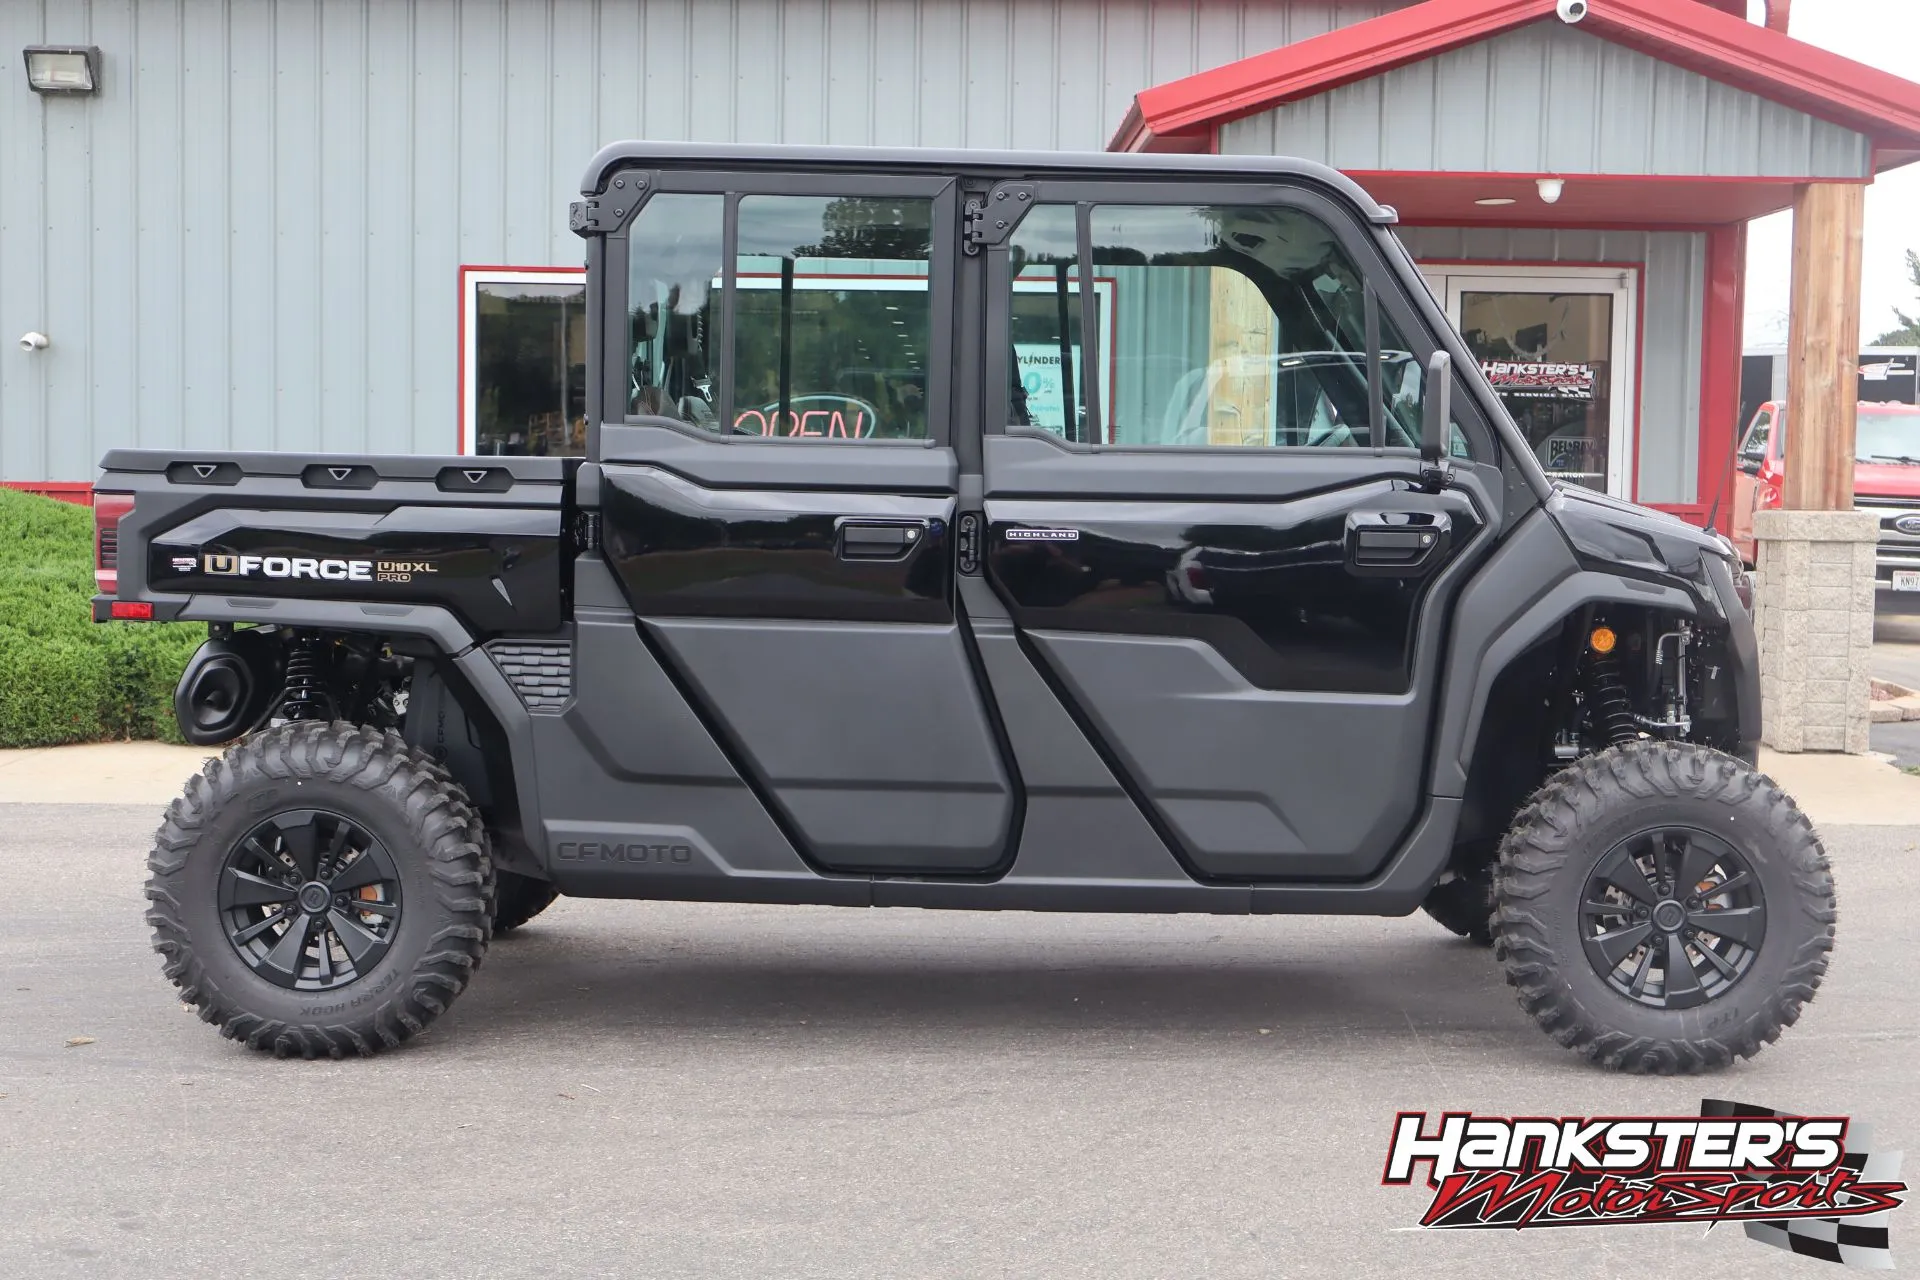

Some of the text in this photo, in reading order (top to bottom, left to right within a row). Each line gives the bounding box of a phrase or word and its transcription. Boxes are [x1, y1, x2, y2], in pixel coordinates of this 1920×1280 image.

[1018, 353, 1061, 367] YLINDER
[377, 572, 411, 583] PRO
[556, 842, 692, 864] CFMOTO
